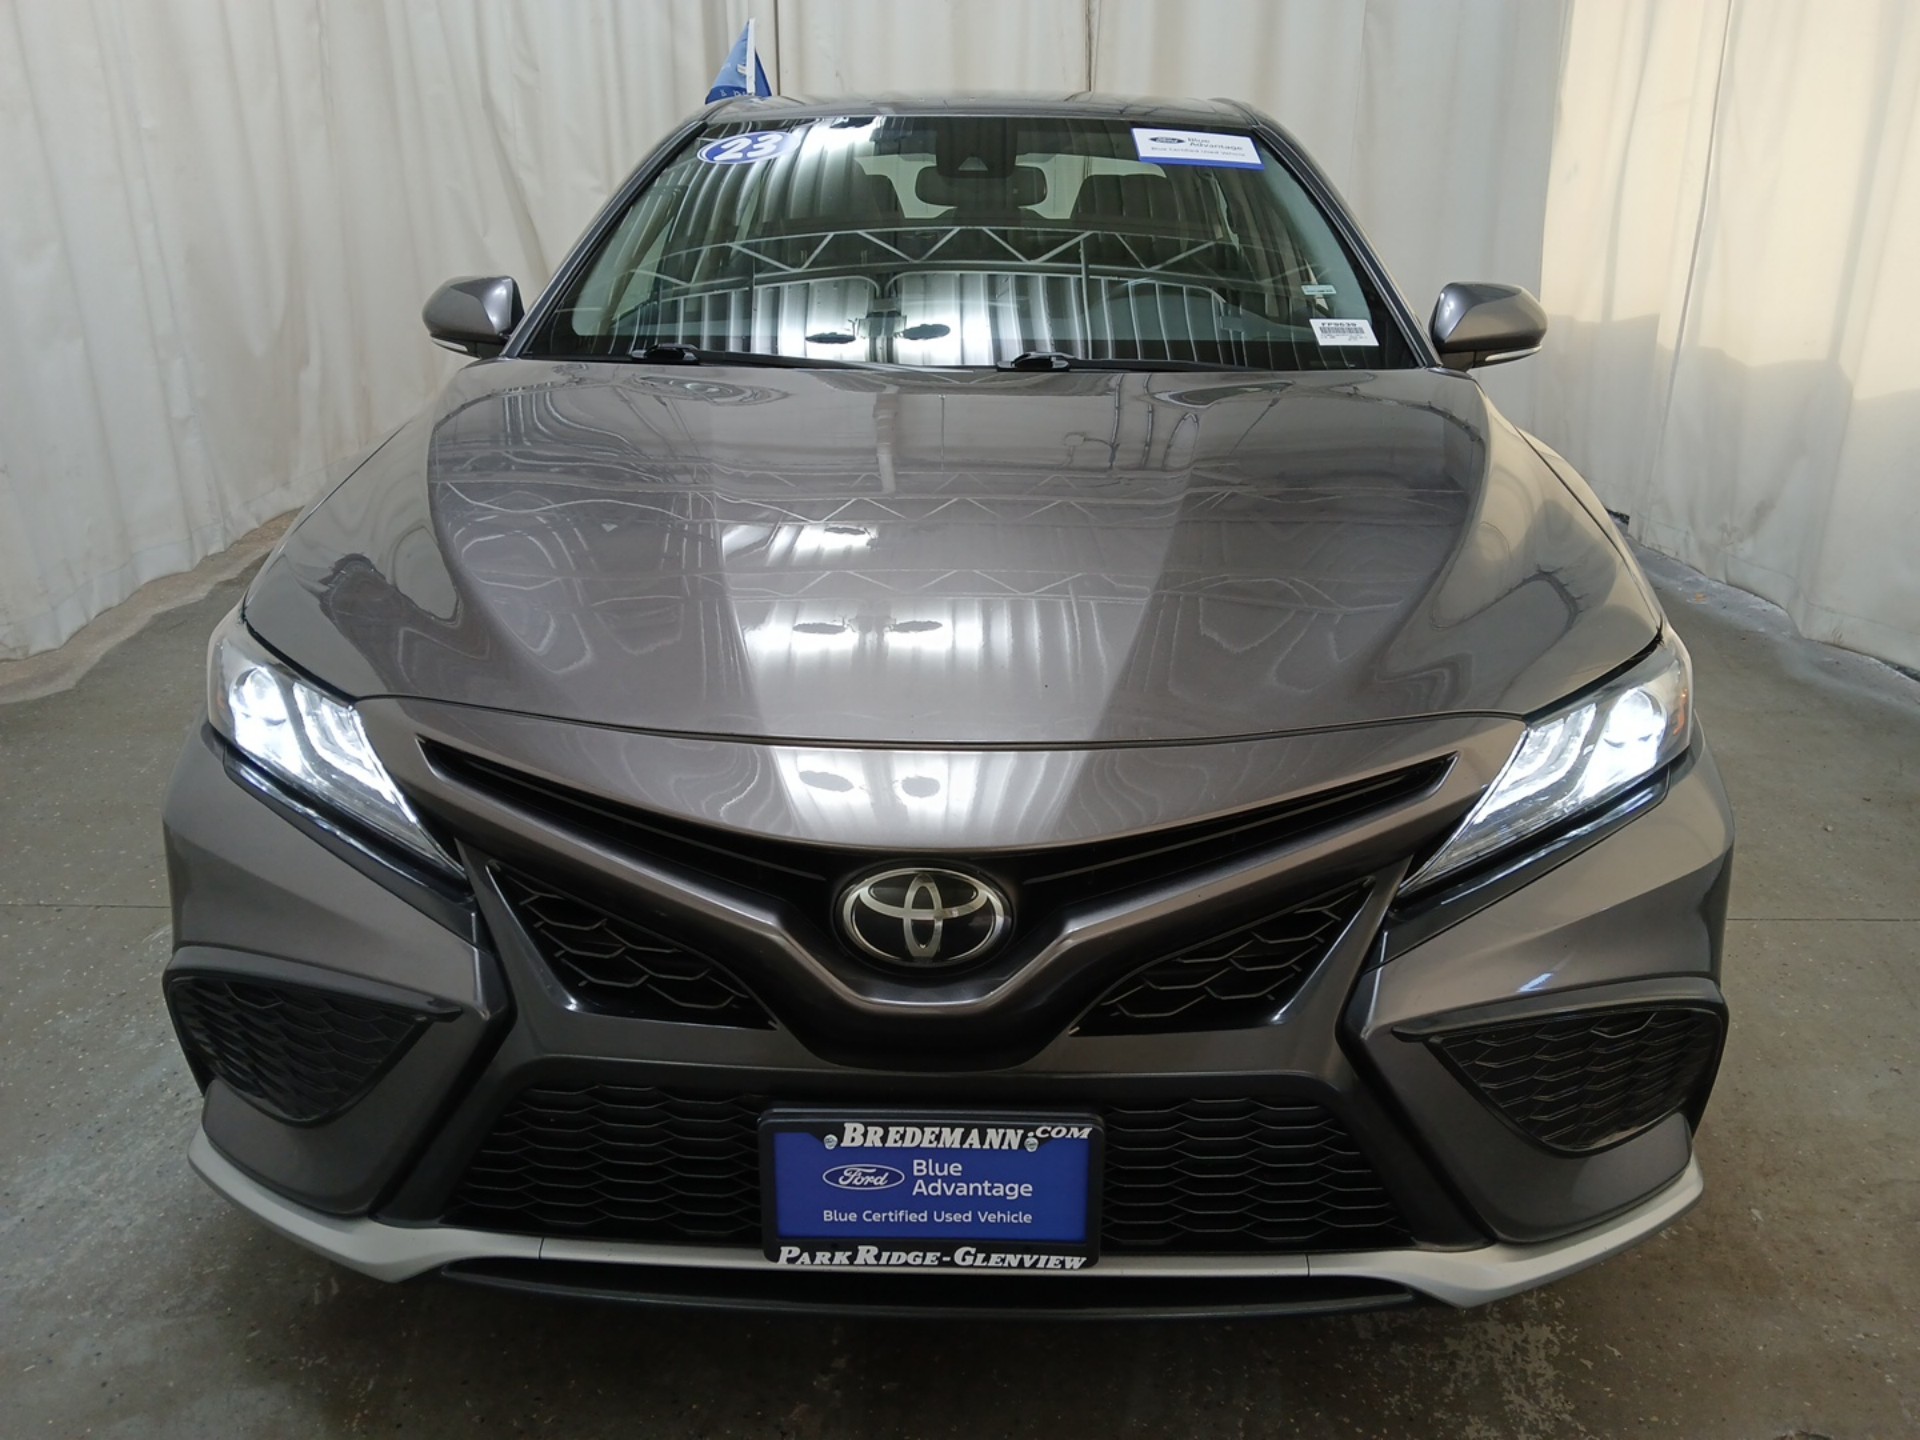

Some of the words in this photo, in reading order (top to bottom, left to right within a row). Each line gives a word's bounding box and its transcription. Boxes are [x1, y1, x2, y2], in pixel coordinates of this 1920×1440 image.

[714, 134, 783, 161] 23
[913, 1159, 962, 1176] Blue
[838, 1167, 888, 1187] Ford
[913, 1180, 1033, 1199] Advantage
[824, 1210, 857, 1222] Blue
[863, 1210, 928, 1222] Certified
[934, 1211, 972, 1222] Used
[978, 1211, 1032, 1223] Vehicle
[778, 1247, 851, 1265] PARK
